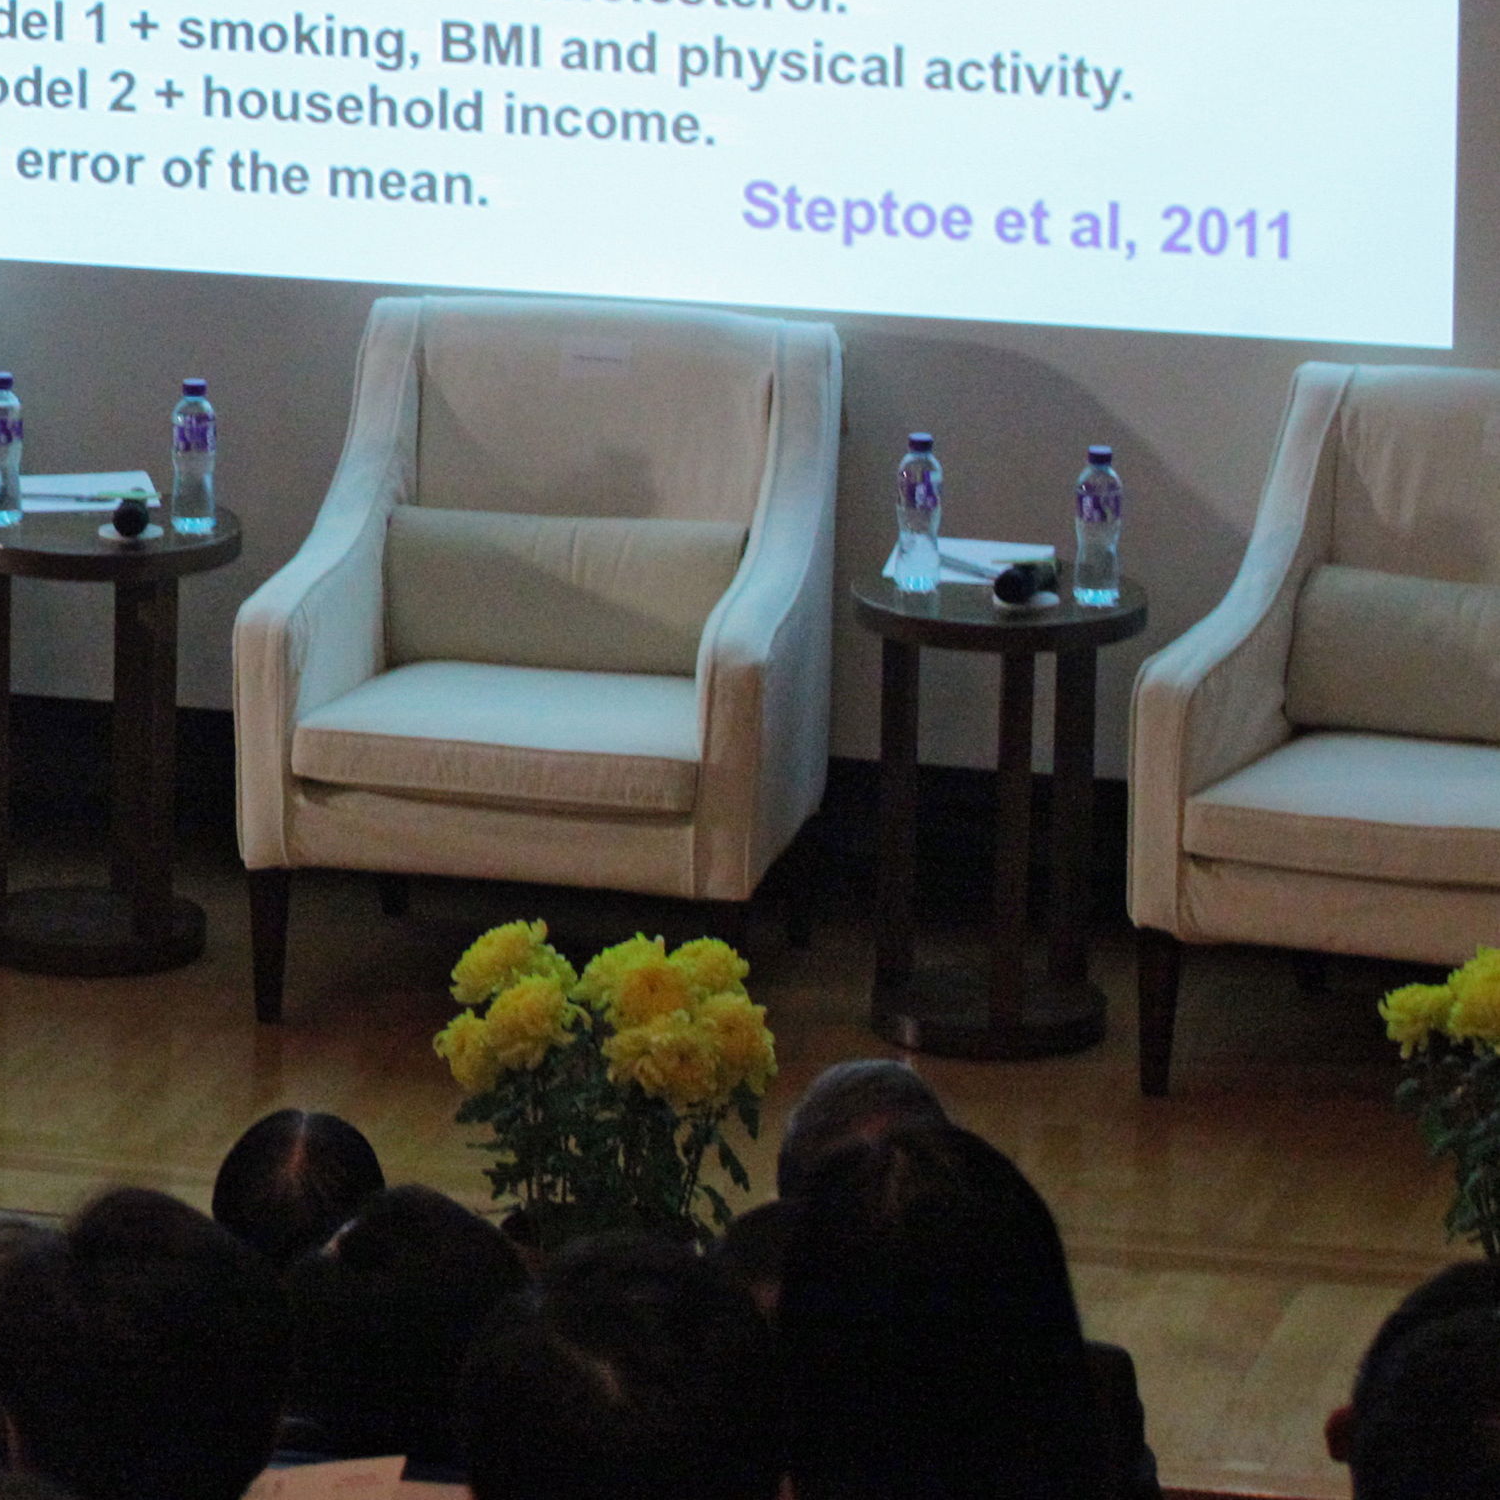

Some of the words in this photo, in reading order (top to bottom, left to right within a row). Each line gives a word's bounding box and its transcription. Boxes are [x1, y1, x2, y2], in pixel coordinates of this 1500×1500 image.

[85, 0, 106, 44] 1
[129, 10, 160, 41] +
[178, 11, 420, 72] smoking,
[441, 19, 542, 68] BMI
[561, 30, 658, 75] and
[679, 34, 905, 92] physical
[924, 50, 1133, 111] activity.
[108, 69, 137, 113] 2
[154, 78, 185, 109] +
[203, 73, 484, 133] household
[505, 90, 716, 146] income.
[16, 147, 146, 186] error
[162, 145, 215, 190] of
[227, 149, 310, 195] the
[329, 165, 489, 207] mean.
[742, 179, 974, 248] Steptoe
[994, 198, 1052, 246] et
[1069, 200, 1138, 261] al,
[1160, 203, 1291, 261] 2011
